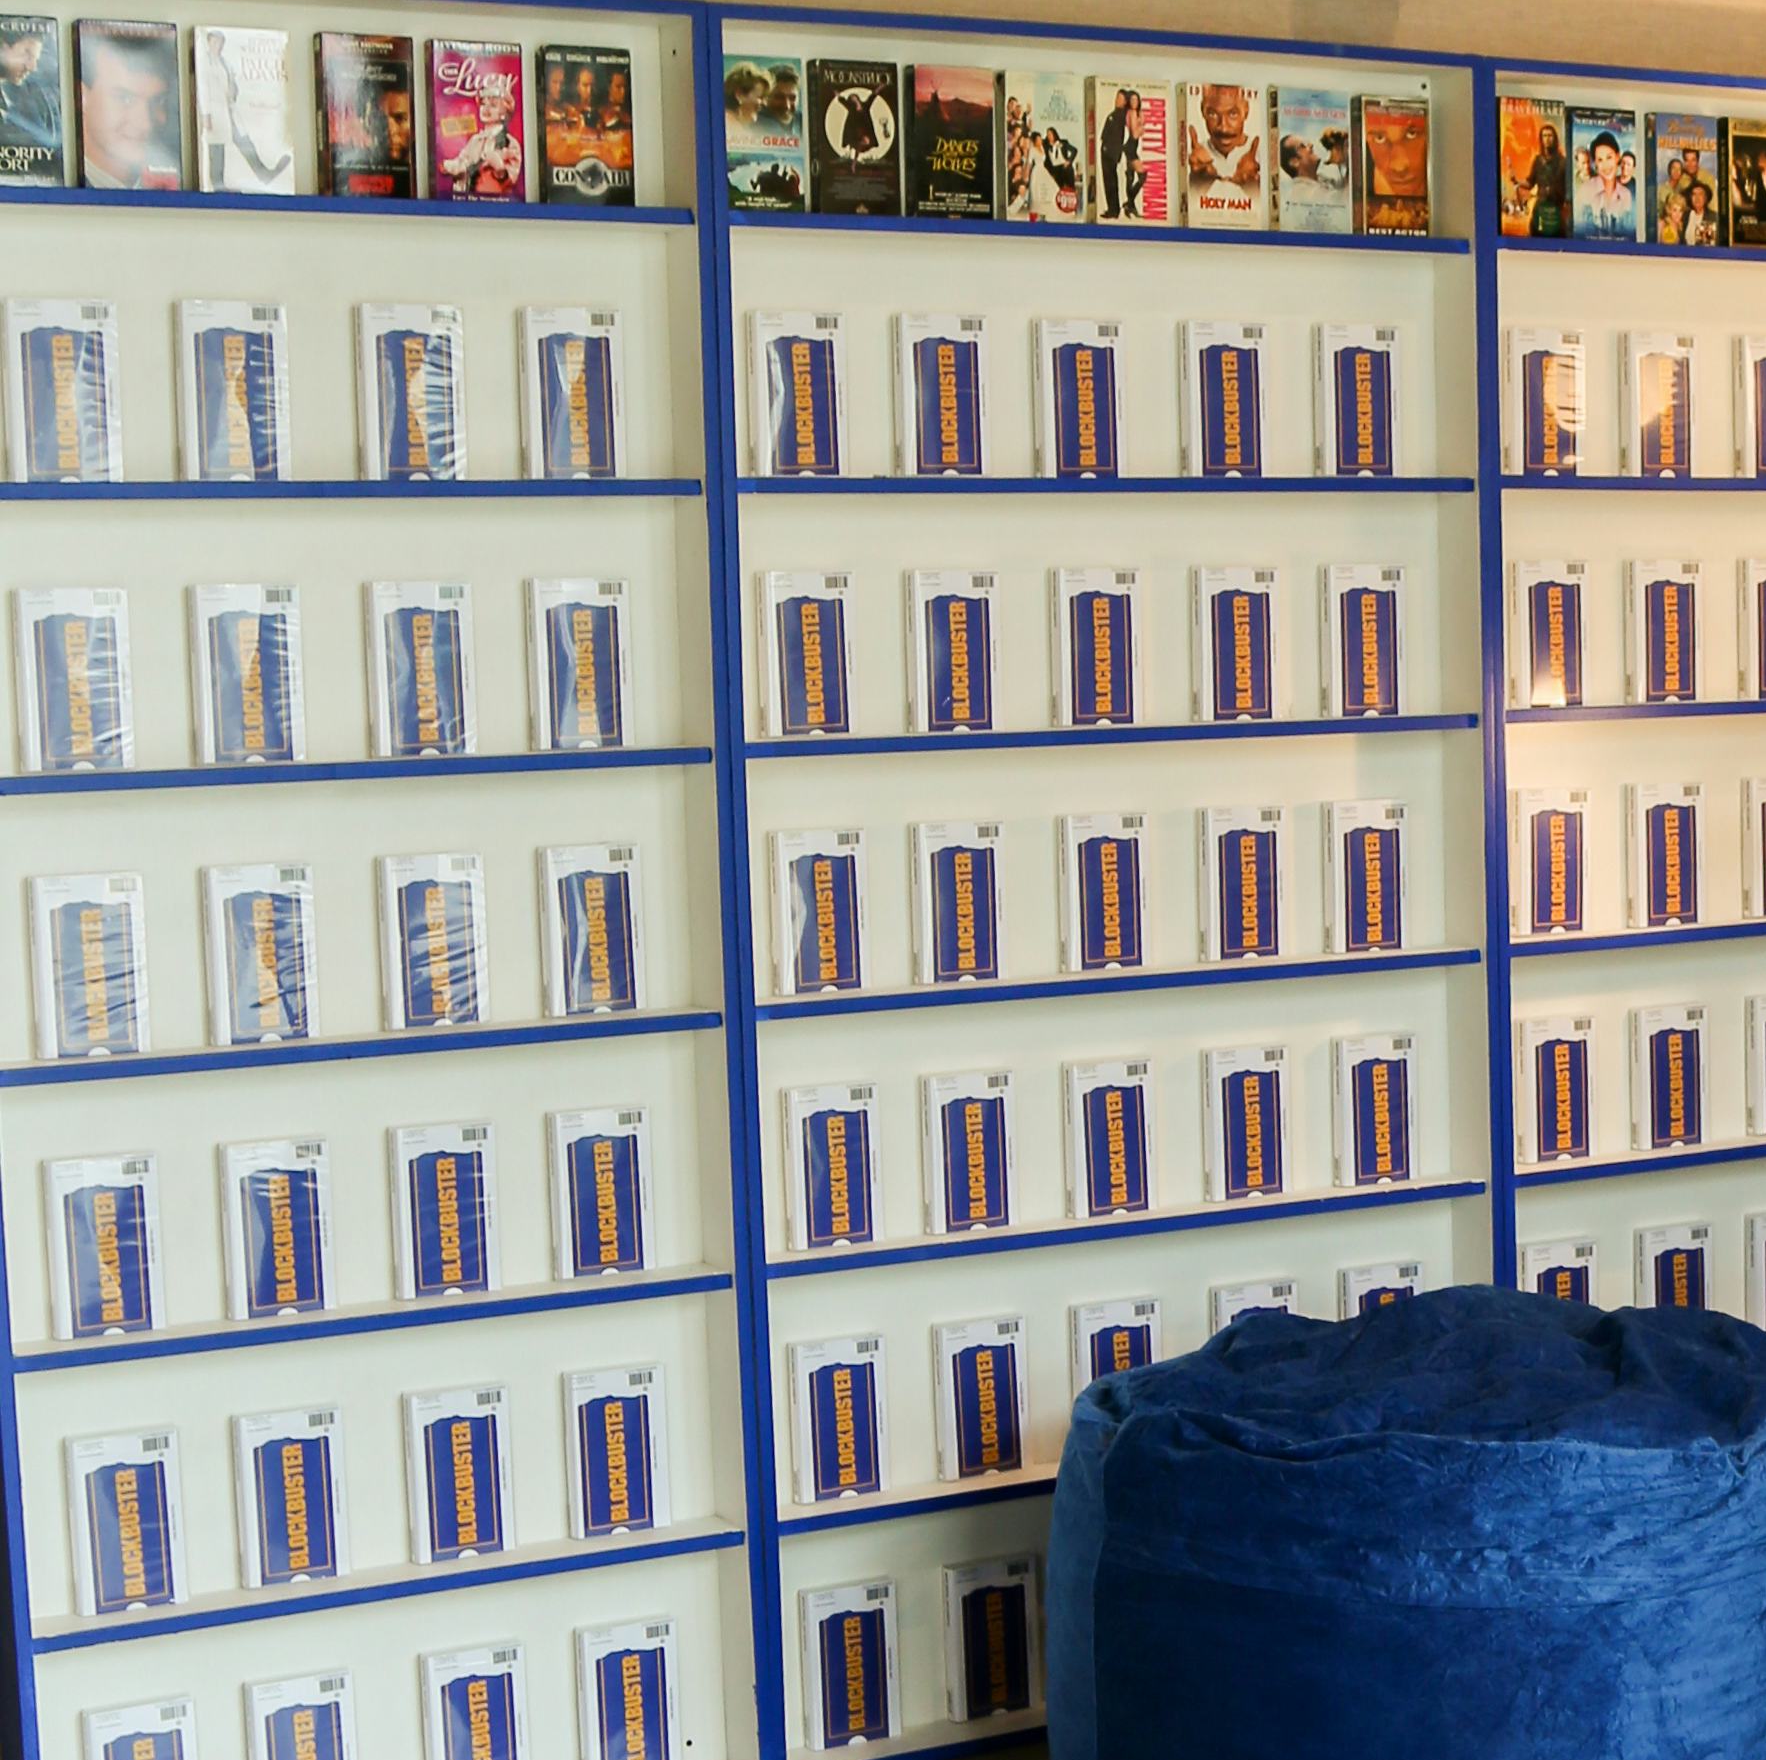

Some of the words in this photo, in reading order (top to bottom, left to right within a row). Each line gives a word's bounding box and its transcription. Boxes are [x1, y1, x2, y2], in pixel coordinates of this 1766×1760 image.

[762, 137, 801, 148] GRACE
[935, 138, 979, 154] DANCES
[1142, 97, 1168, 155] PRETTY
[1200, 196, 1227, 210] HOLY
[1227, 198, 1252, 211] MAN
[792, 343, 815, 467] BLOCKBUSTER
[938, 345, 958, 466] BLOCKBUSTER
[1076, 351, 1096, 468] BLOCKBUSTER
[1222, 351, 1241, 467] BLOCKBUSTER
[1356, 354, 1373, 467] BLOCKBUSTER
[801, 604, 825, 726] BLOCKBUSTER
[950, 602, 970, 722] BLOCKBUSTER
[1093, 599, 1111, 716] BLOCKBUSTER
[1233, 596, 1252, 713] BLOCKBUSTER
[1362, 595, 1380, 709] BLOCKBUSTER
[1664, 586, 1679, 694] BLOCKBUSTER
[955, 853, 976, 972] BLOCKBUSTER
[1101, 843, 1121, 960] BLOCKBUSTER
[1240, 836, 1258, 950] BLOCKBUSTER
[1364, 833, 1382, 945] BLOCKBUSTER
[1549, 814, 1565, 925] BLOCKBUSTER
[1664, 809, 1680, 916] BLOCKBUSTER
[814, 861, 837, 983] BLOCKBUSTER
[1244, 1076, 1263, 1189] BLOCKBUSTER
[1373, 1064, 1391, 1177] BLOCKBUSTER
[1555, 1045, 1571, 1153] BLOCKBUSTER
[1668, 1034, 1684, 1139] BLOCKBUSTER
[594, 1142, 618, 1266] BLOCKBUSTER
[827, 1116, 849, 1237] BLOCKBUSTER
[965, 1103, 986, 1221] BLOCKBUSTER
[1106, 1092, 1127, 1208] BLOCKBUSTER
[94, 1193, 123, 1325] BLOCKBUSTER
[269, 1176, 297, 1305] BLOCKBUSTER
[436, 1158, 461, 1285] BLOCKBUSTER
[605, 1403, 628, 1525] BLOCKBUSTER
[834, 1370, 857, 1488] BLOCKBUSTER
[976, 1352, 999, 1468] BLOCKBUSTER
[115, 1470, 146, 1602] BLOCKBUSTER
[282, 1444, 309, 1573] BLOCKBUSTER
[451, 1422, 477, 1546] BLOCKBUSTER
[844, 1617, 865, 1732] BLOCKBUSTER
